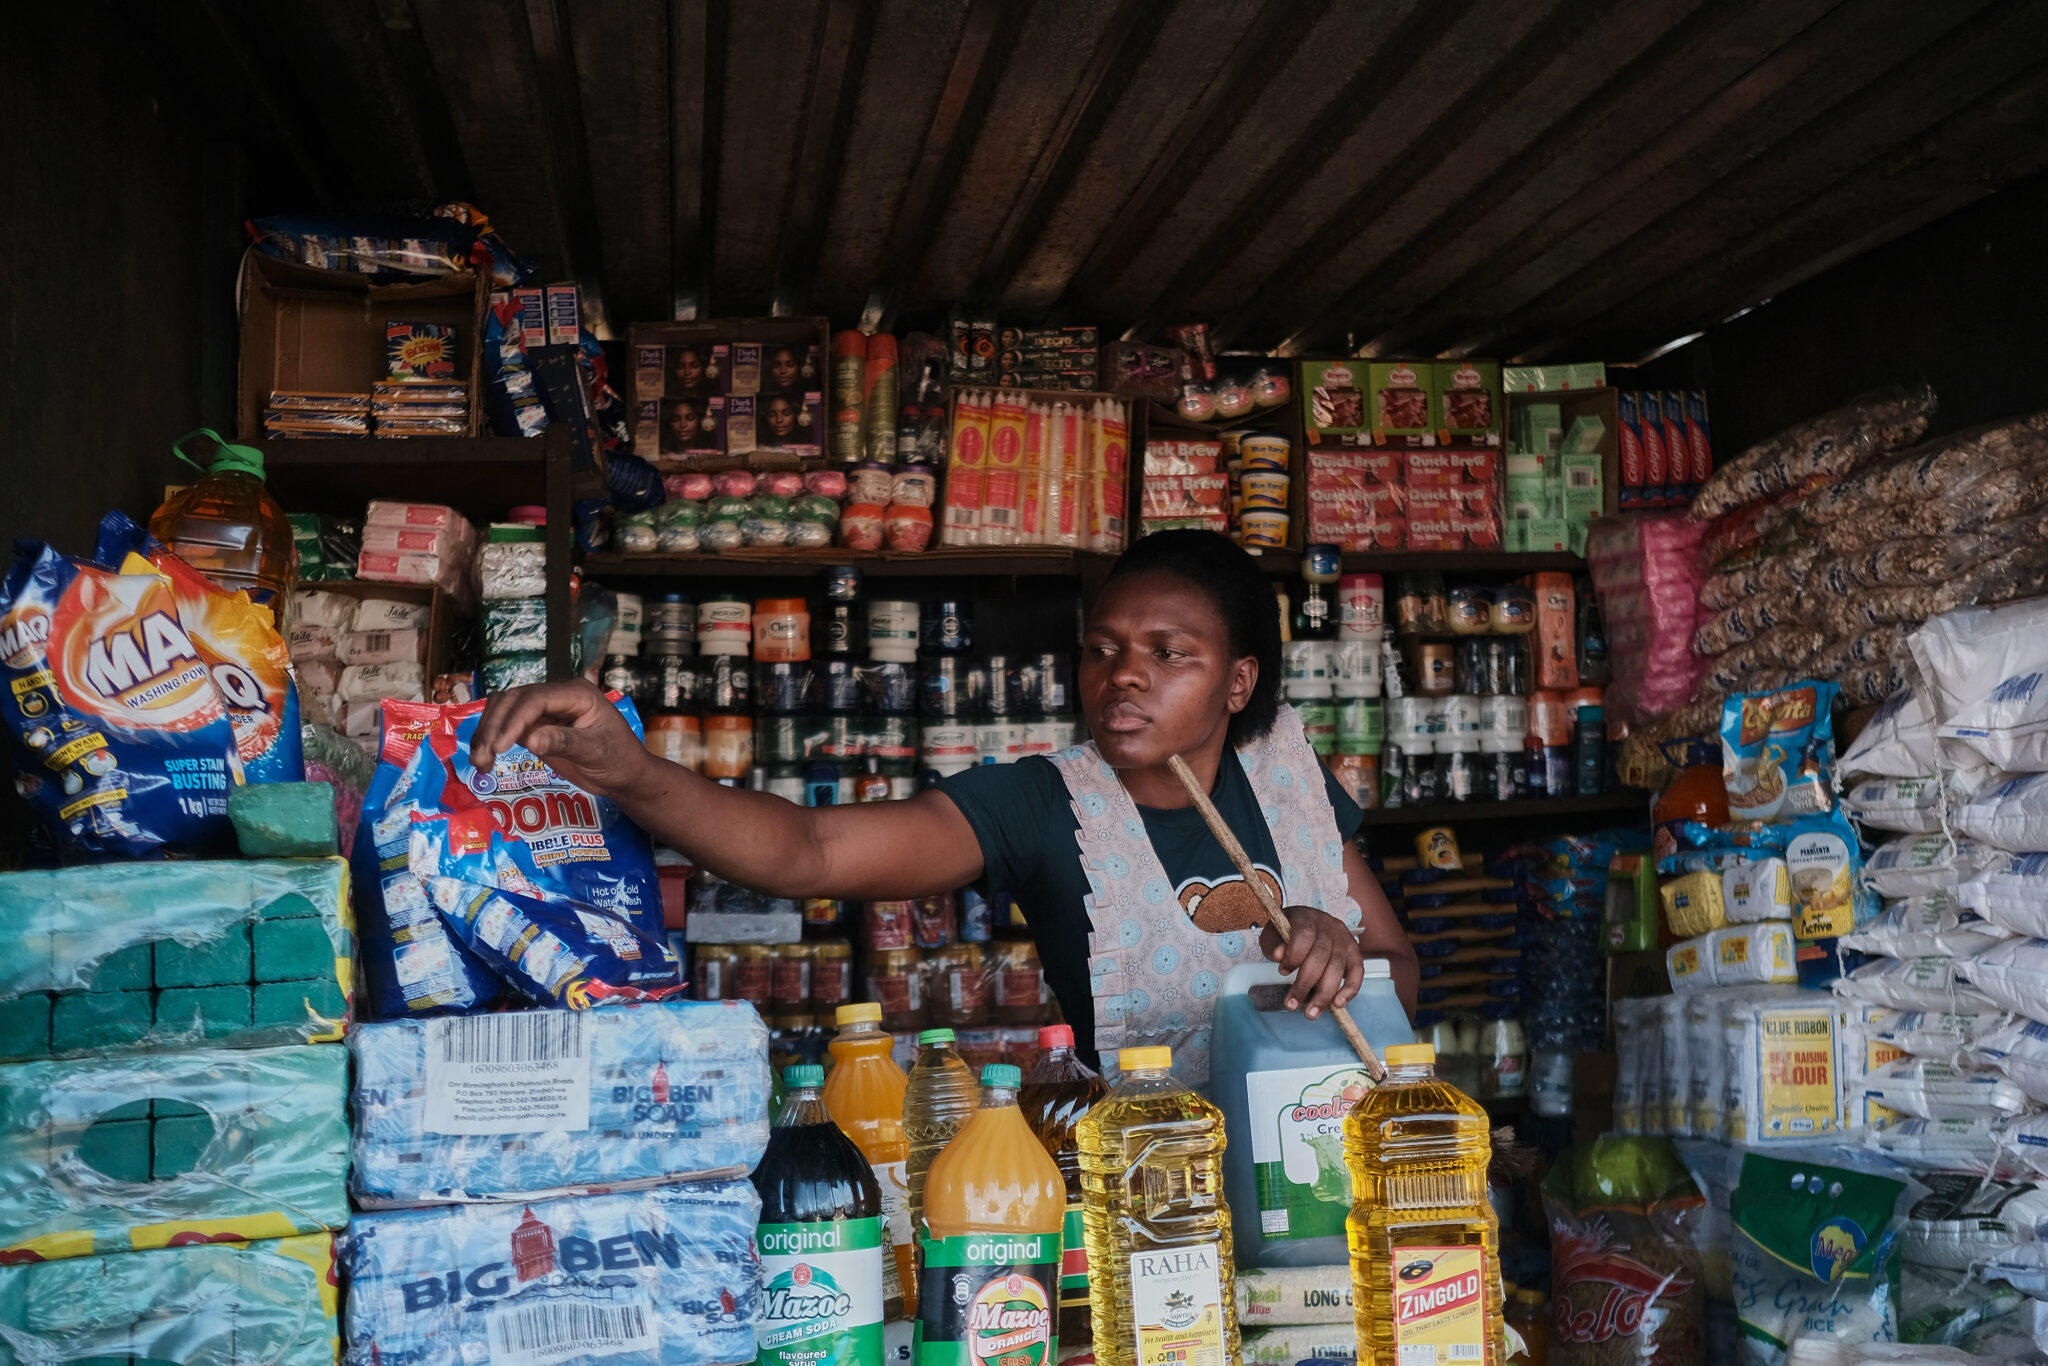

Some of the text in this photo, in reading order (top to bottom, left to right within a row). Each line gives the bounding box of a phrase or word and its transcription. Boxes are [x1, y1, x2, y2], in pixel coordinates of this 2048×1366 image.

[1178, 443, 1220, 457] Brew
[1268, 446, 1285, 454] Band
[1626, 430, 1639, 483] Colgate
[1648, 430, 1662, 482] Colgate
[1671, 428, 1684, 481] Colgate
[1694, 426, 1707, 481] Colgate
[1311, 456, 1391, 468] Quick Brew
[1409, 455, 1486, 468] Quick Brew
[1182, 477, 1226, 490] Brew
[1409, 488, 1485, 500] Quick Brew
[1410, 522, 1487, 533] Quick Brew
[384, 605, 410, 618] Jade
[358, 666, 382, 680] Jade
[126, 663, 207, 711] WASHING POW
[164, 758, 226, 773] SUPER STAIN
[496, 760, 546, 778] PACK
[172, 774, 227, 791] BUSTING
[498, 778, 550, 790] CELLULASES
[515, 771, 548, 783] EXTRA
[178, 798, 188, 816] 1
[188, 798, 204, 818] kg
[572, 834, 604, 846] PLUS
[568, 848, 609, 858] POWDER
[592, 886, 610, 898] Hot
[1801, 918, 1833, 936] Active
[1794, 1020, 1829, 1036] RIBBON
[1794, 1050, 1828, 1064] RAISING
[1769, 1066, 1829, 1086] FLOUR
[462, 1080, 508, 1090] Birmingham
[612, 1085, 714, 1104] BIG BEN
[632, 1104, 696, 1123] SOAP
[1804, 1104, 1830, 1114] Quality
[679, 1130, 703, 1140] BAR
[660, 1198, 715, 1207] LAUNDRY
[763, 1224, 841, 1255] original
[966, 1236, 1042, 1266] original
[401, 1230, 683, 1314] BIG BEN
[1138, 1250, 1211, 1278] RAHA
[1152, 1272, 1201, 1284] PREMIUM QUALITY
[760, 1288, 851, 1320] Mazoe
[1304, 1289, 1341, 1308] LONG
[1400, 1274, 1479, 1320] ZIMGOLD
[682, 1300, 722, 1316] BIG
[972, 1302, 1050, 1330] Mazoe
[1403, 1306, 1478, 1338] OIL THAT LASTS LONGER
[698, 1324, 752, 1338] LAUNDRY
[766, 1320, 838, 1346] CREAM SODA
[1154, 1333, 1174, 1344] health
[1175, 1332, 1188, 1341] and
[1188, 1328, 1218, 1341] happiness
[988, 1329, 1040, 1352] ORANGE
[778, 1350, 828, 1361] flavoured
[999, 1354, 1033, 1366] crush
